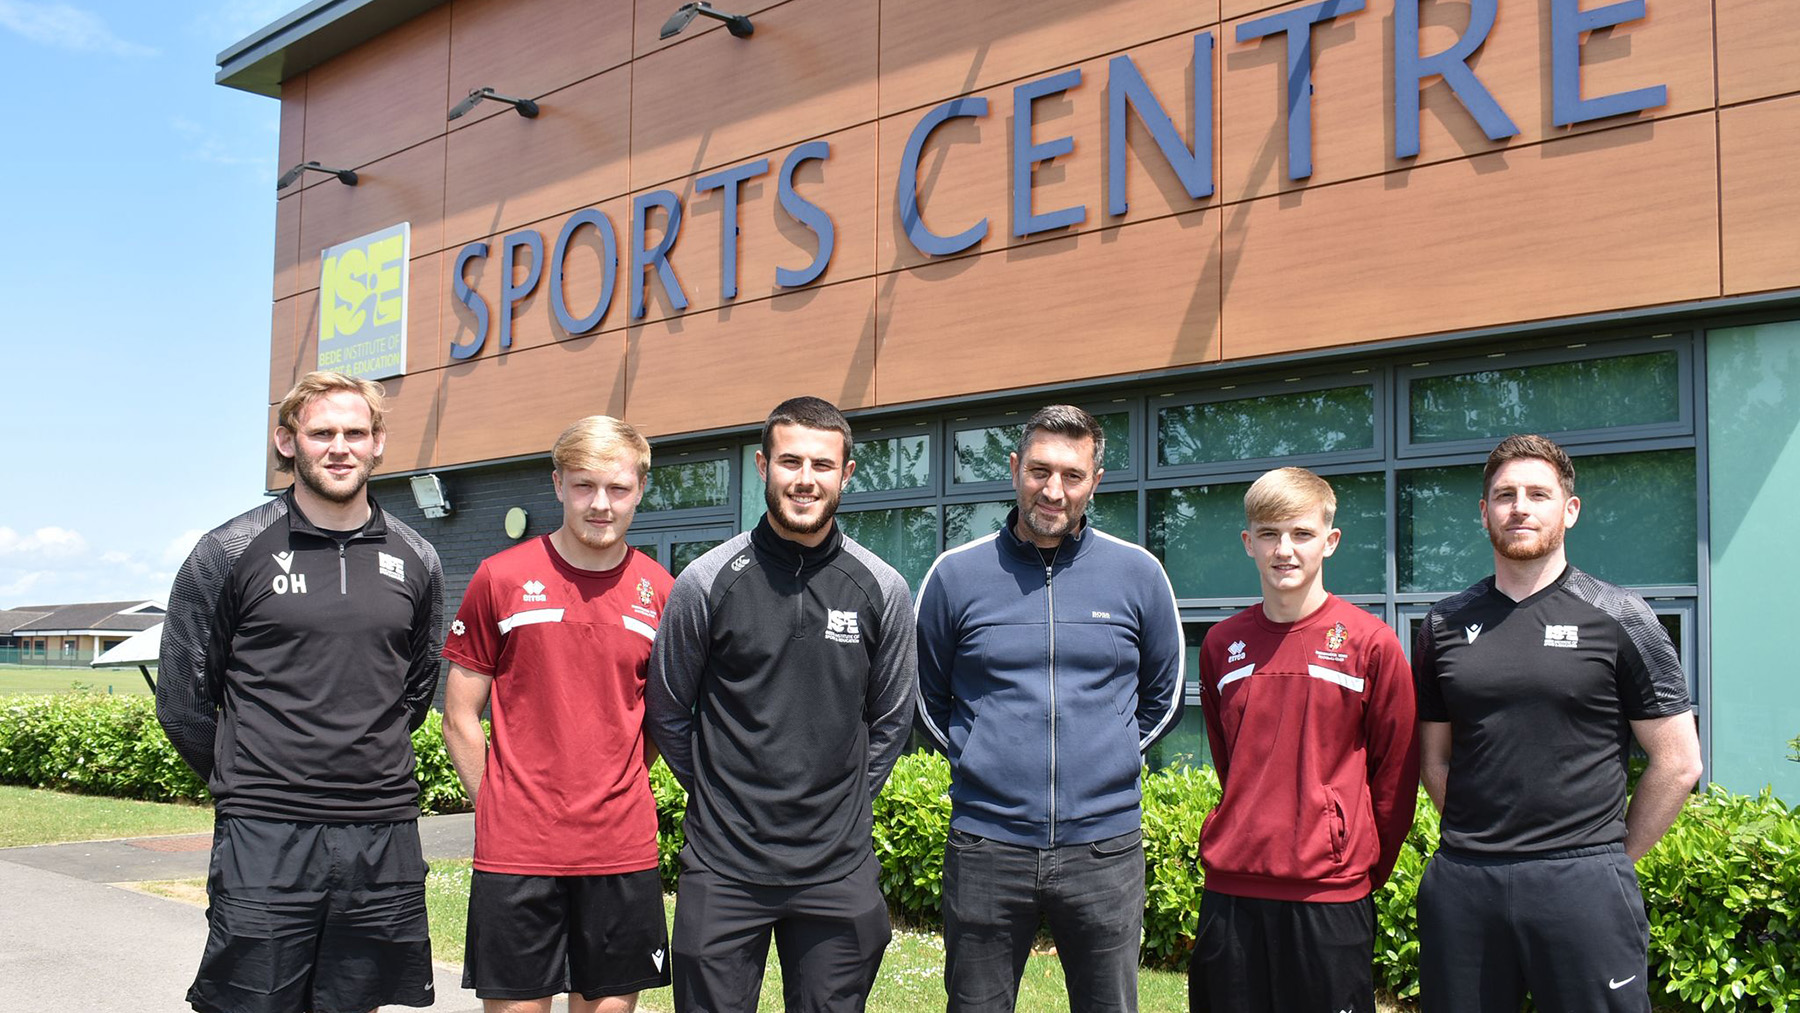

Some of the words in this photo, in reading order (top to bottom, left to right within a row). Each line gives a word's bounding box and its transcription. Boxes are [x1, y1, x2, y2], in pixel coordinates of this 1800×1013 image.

[450, 141, 834, 359] SPORTS
[898, 0, 1667, 256] CENTRE
[319, 349, 342, 365] BEDE
[344, 338, 386, 360] INSTITUTE
[388, 334, 400, 350] OF
[353, 352, 400, 375] EDUCATION
